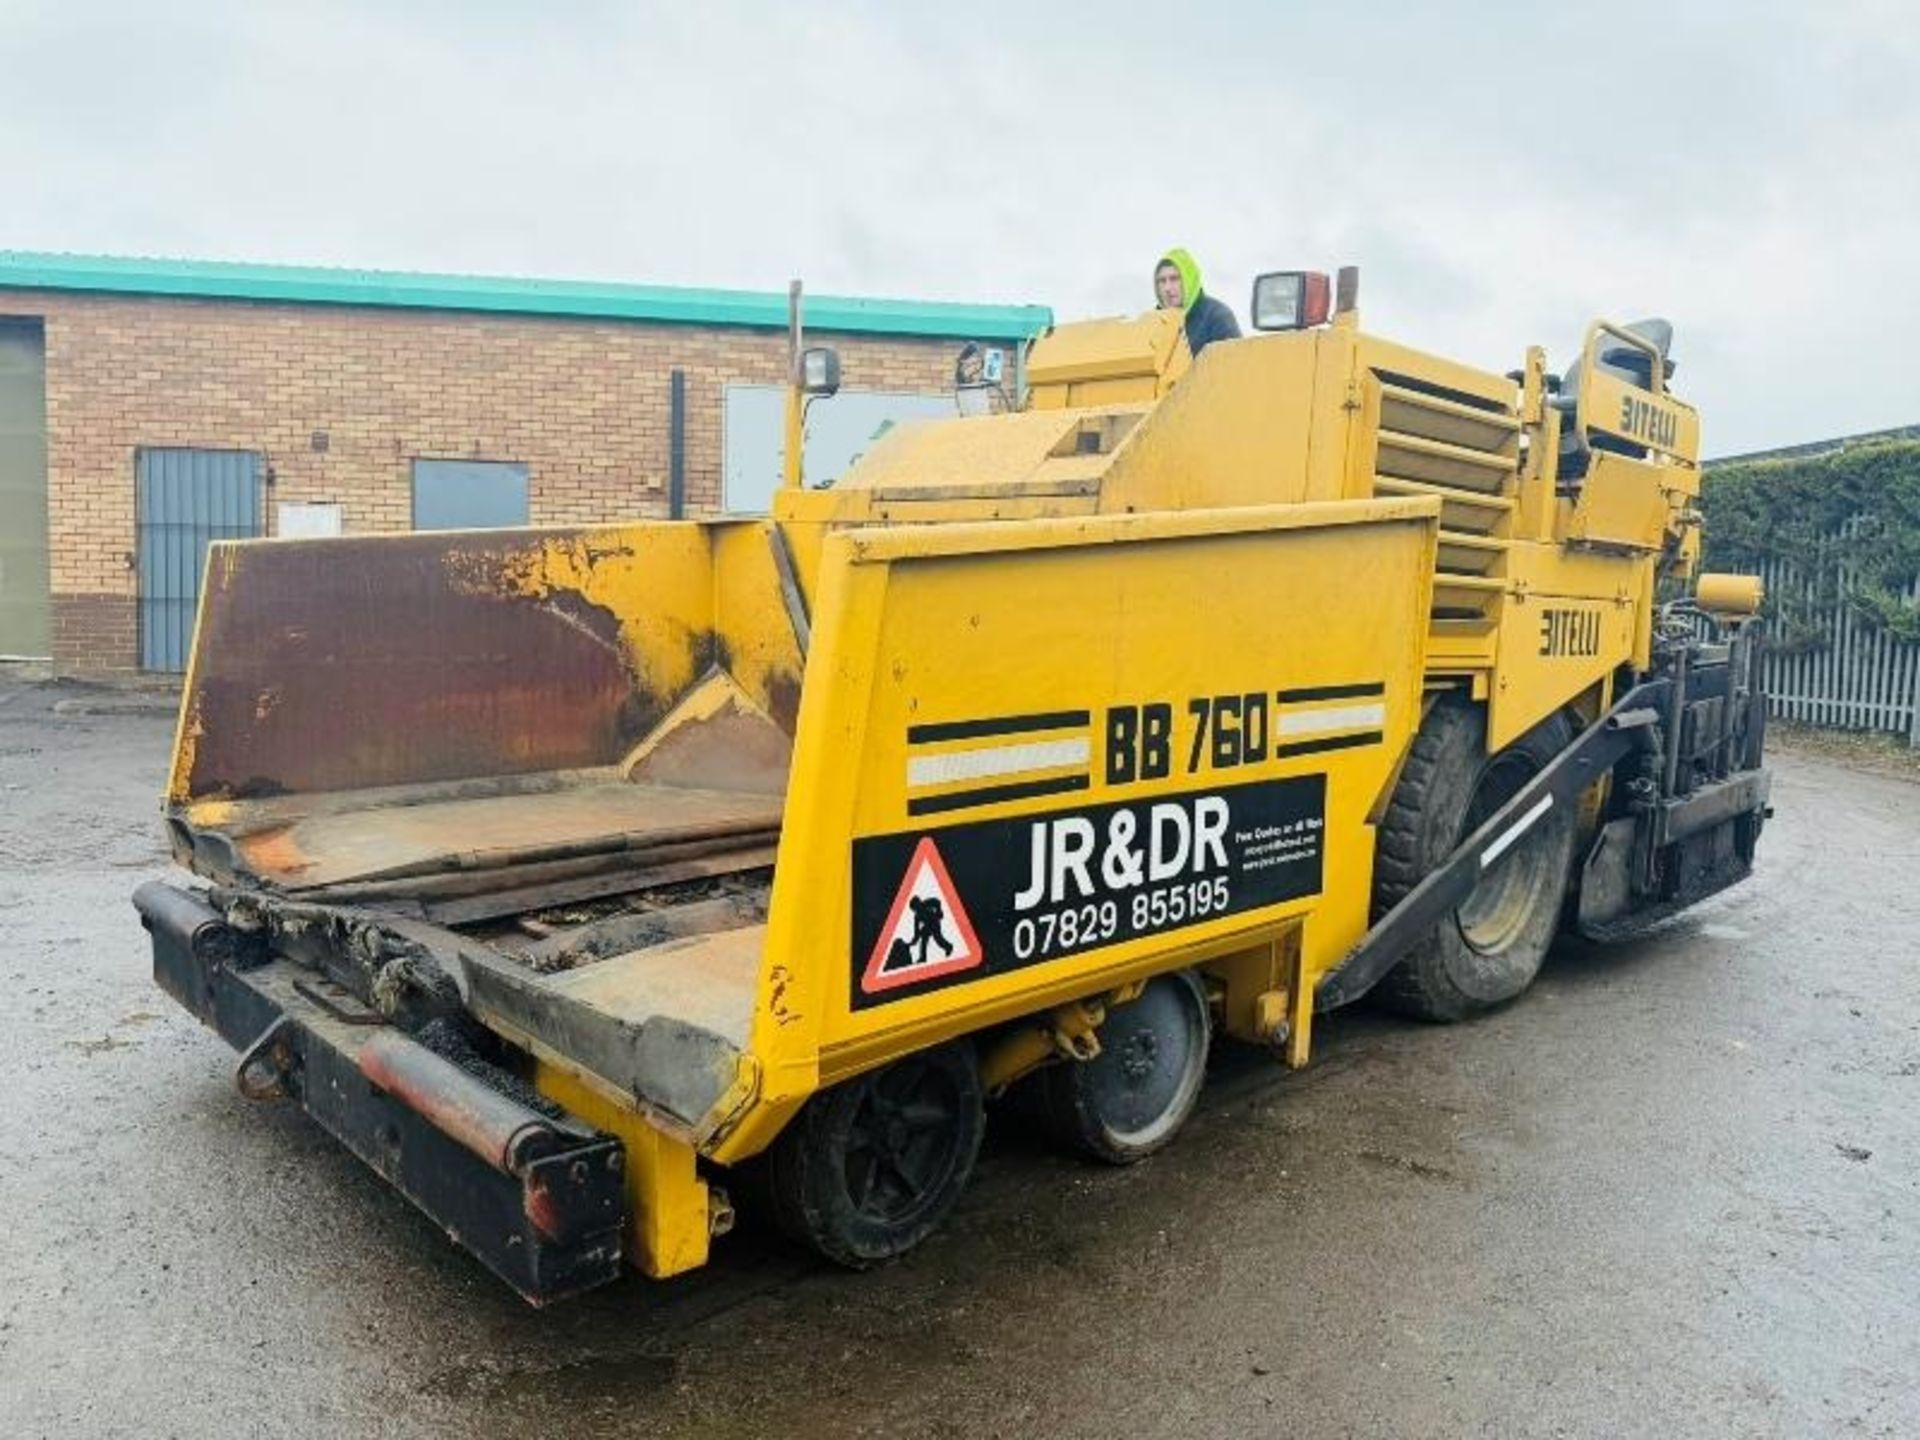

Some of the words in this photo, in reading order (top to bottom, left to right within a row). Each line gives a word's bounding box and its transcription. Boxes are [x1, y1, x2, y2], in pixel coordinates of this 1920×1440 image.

[1106, 703, 1173, 785] BB
[1188, 693, 1269, 773] 760
[1014, 796, 1230, 911] JR&DR
[1013, 903, 1117, 959] 07829
[1132, 875, 1229, 930] 855195
